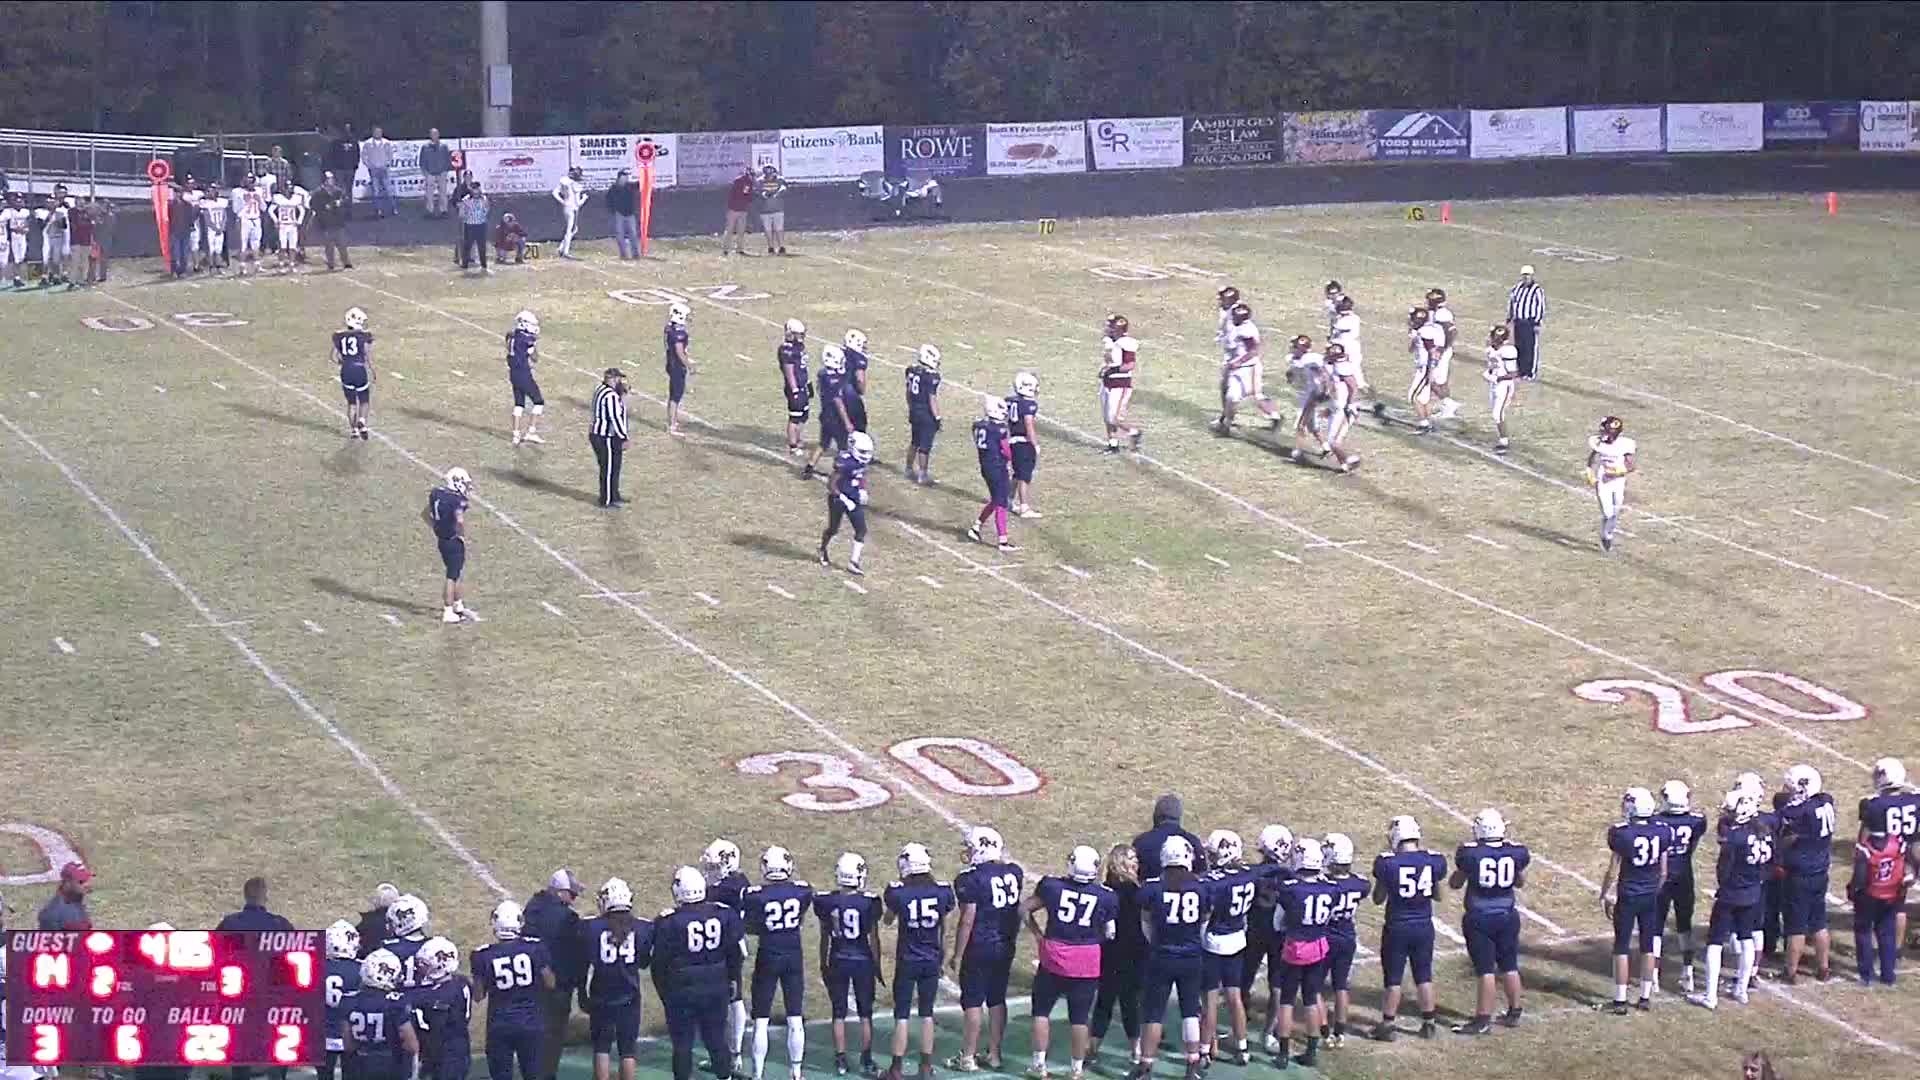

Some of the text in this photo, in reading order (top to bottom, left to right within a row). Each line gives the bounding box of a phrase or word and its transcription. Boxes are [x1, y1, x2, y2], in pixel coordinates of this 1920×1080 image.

[580, 137, 628, 148] SHAFER'S
[782, 136, 836, 149] Citizens
[850, 132, 882, 146] Bank
[901, 136, 973, 159] ROWE
[1040, 220, 1056, 235] 10
[524, 244, 540, 260] 20
[340, 336, 358, 356] 13
[1571, 669, 1868, 735] 20
[735, 736, 1043, 812] 30
[1886, 803, 1918, 836] 65
[1633, 835, 1661, 866] 31
[1747, 834, 1773, 865] 35
[1399, 866, 1433, 898] 54
[1479, 856, 1515, 888] 60
[990, 873, 1019, 908] 63
[1229, 882, 1256, 917] 52
[764, 898, 800, 930] 22
[831, 908, 860, 939] 19
[907, 898, 939, 929] 15
[1057, 890, 1098, 926] 57
[1163, 891, 1200, 924] 78
[1302, 894, 1332, 925] 16
[600, 930, 635, 963] 64
[687, 917, 721, 952] 69
[493, 953, 533, 990] 59
[349, 1012, 386, 1042] 27
